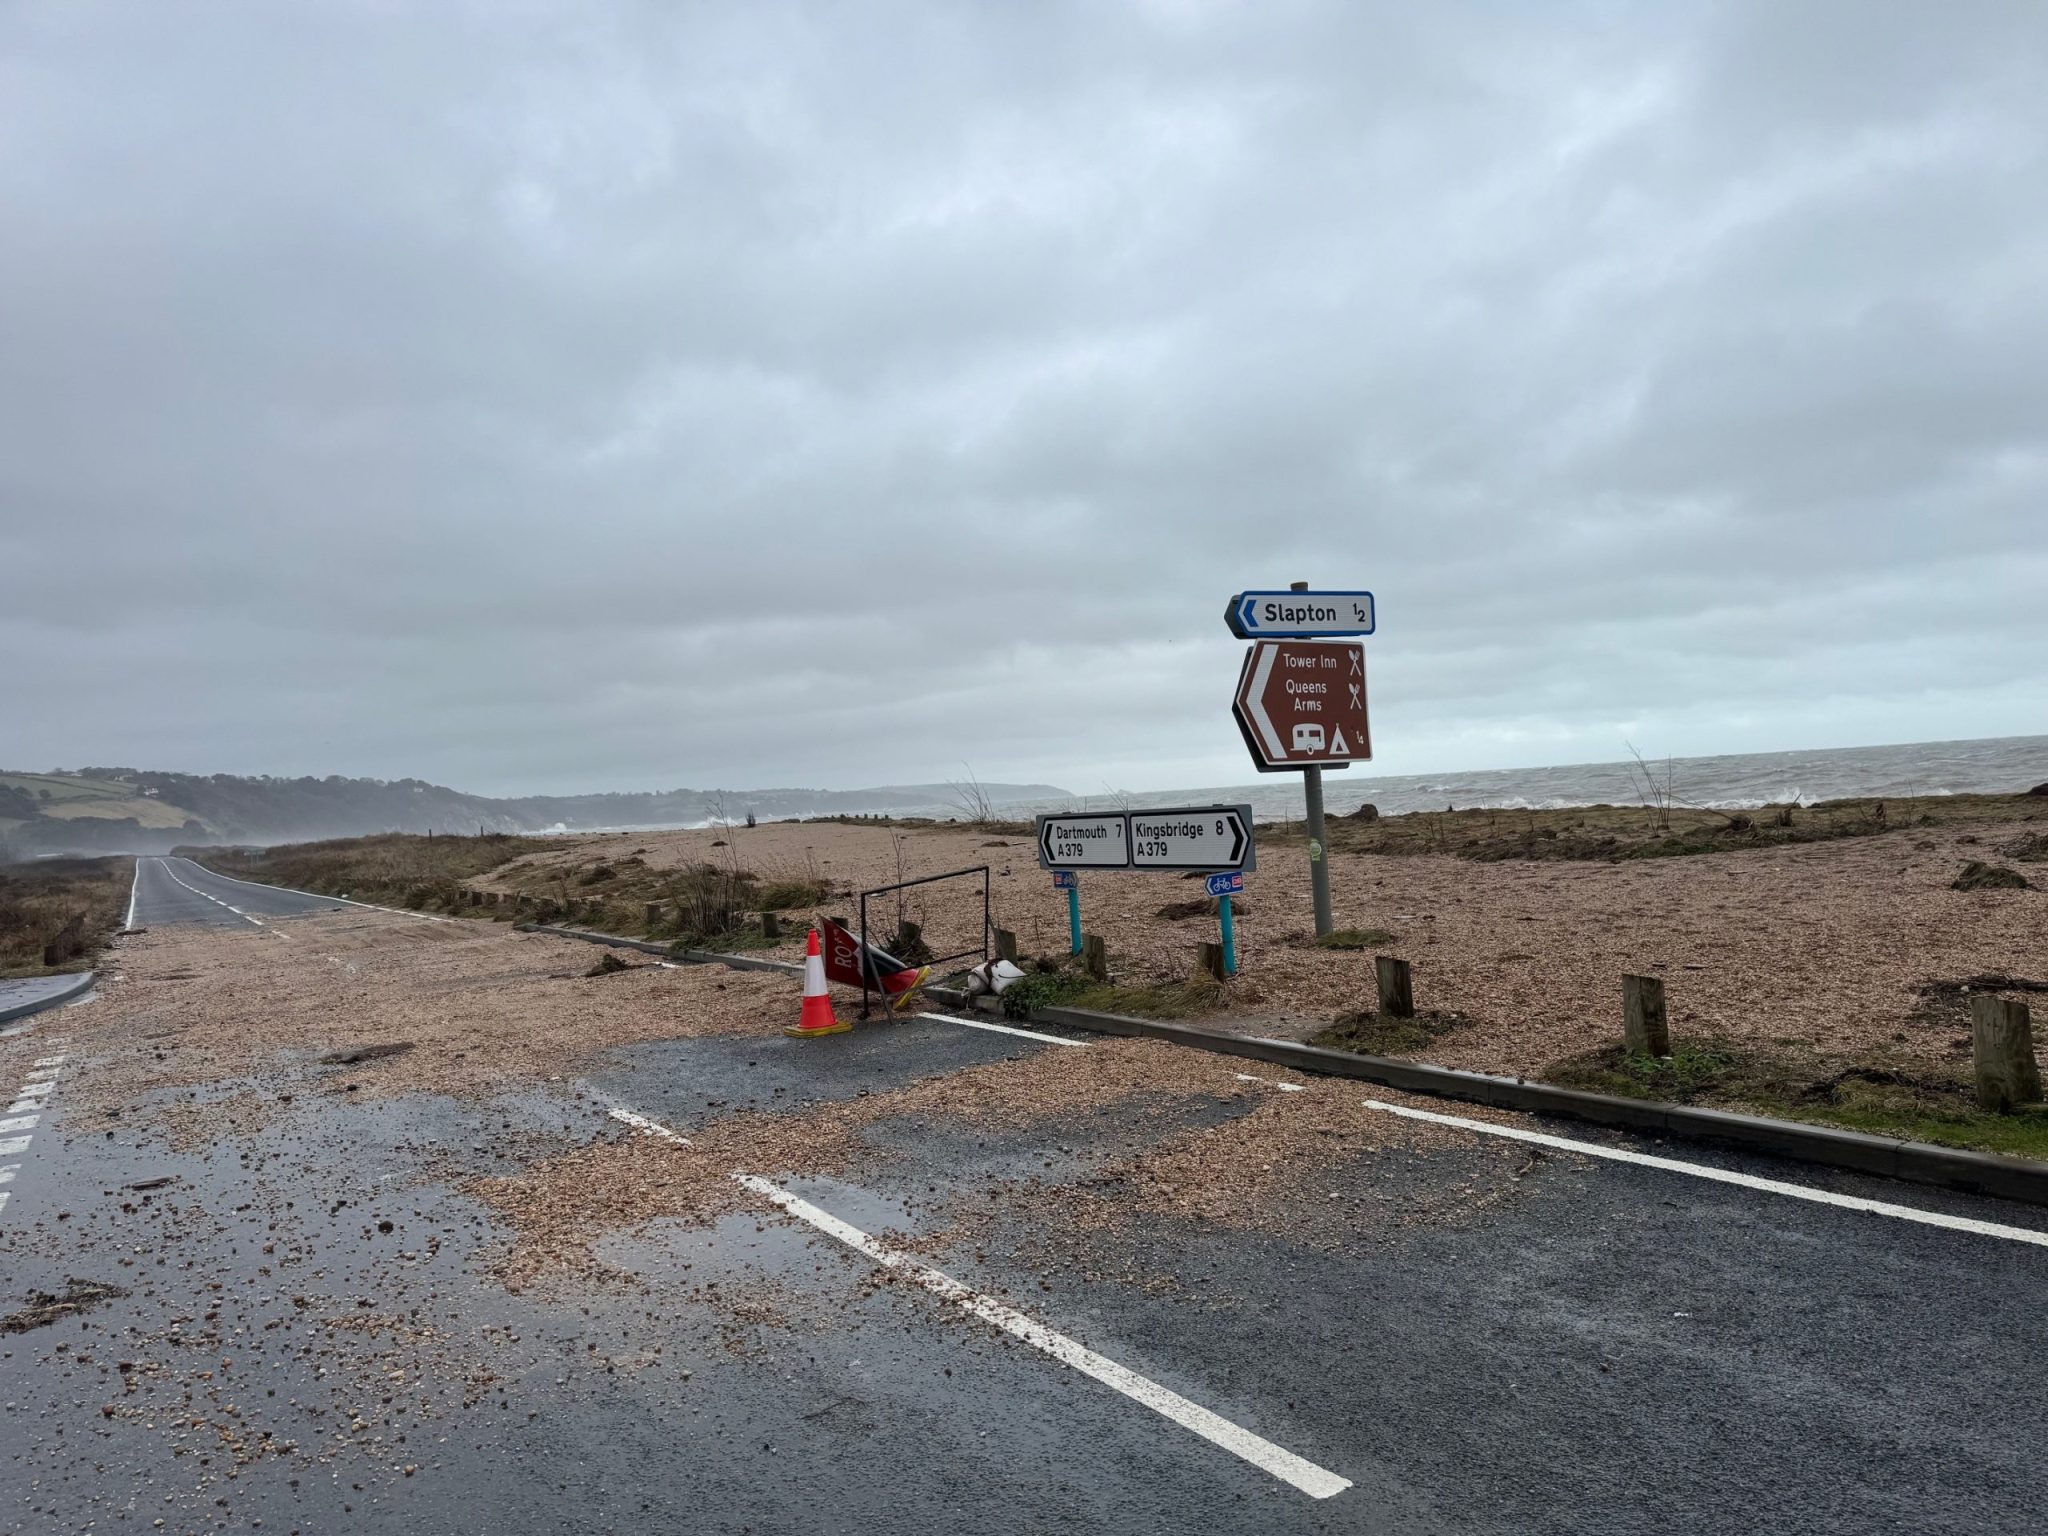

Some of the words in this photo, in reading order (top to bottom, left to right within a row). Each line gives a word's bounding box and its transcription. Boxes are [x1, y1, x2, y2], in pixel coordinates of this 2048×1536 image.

[1264, 603, 1337, 624] Slapton
[1283, 653, 1316, 668] Tower
[1320, 654, 1337, 669] Inn
[1285, 679, 1327, 694] Queens
[1294, 698, 1322, 712] Arms
[1056, 824, 1107, 840] Dartmouth
[1116, 824, 1122, 838] 7
[1136, 821, 1203, 840] Kingsbridge
[1215, 820, 1224, 836] 8
[1057, 843, 1083, 857] A379
[1137, 842, 1168, 857] A379
